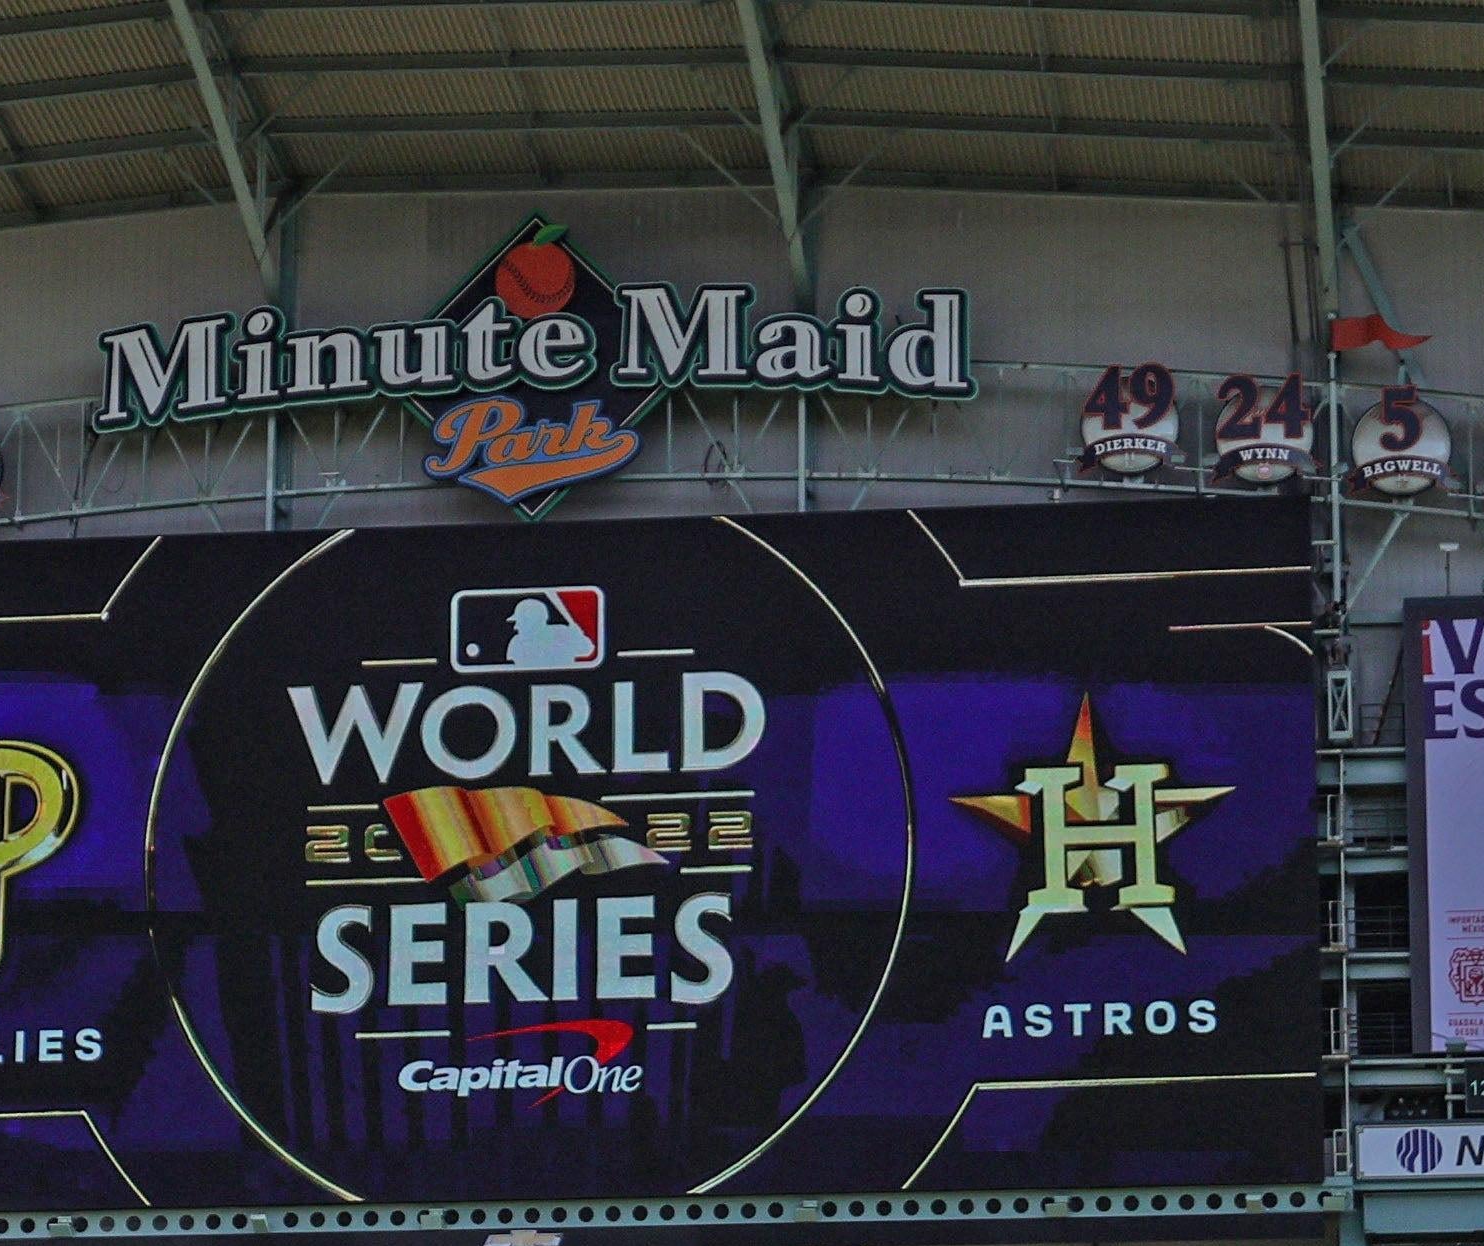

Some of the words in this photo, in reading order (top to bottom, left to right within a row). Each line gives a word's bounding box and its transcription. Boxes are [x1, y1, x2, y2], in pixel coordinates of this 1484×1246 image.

[98, 295, 596, 428] Minute
[614, 284, 972, 398] Maid
[1083, 361, 1176, 431] 49
[1217, 371, 1314, 440] 24
[1381, 384, 1424, 452] 5
[425, 394, 640, 492] Park
[1094, 437, 1168, 456] DIERKER
[1239, 446, 1290, 461] WYNN
[1363, 459, 1442, 478] BAGWELL
[287, 671, 767, 785] WORLD
[1024, 763, 1176, 906] H
[310, 891, 734, 1014] SERIES
[982, 1000, 1217, 1039] ASTROS
[397, 1054, 644, 1097] CapitalOne
